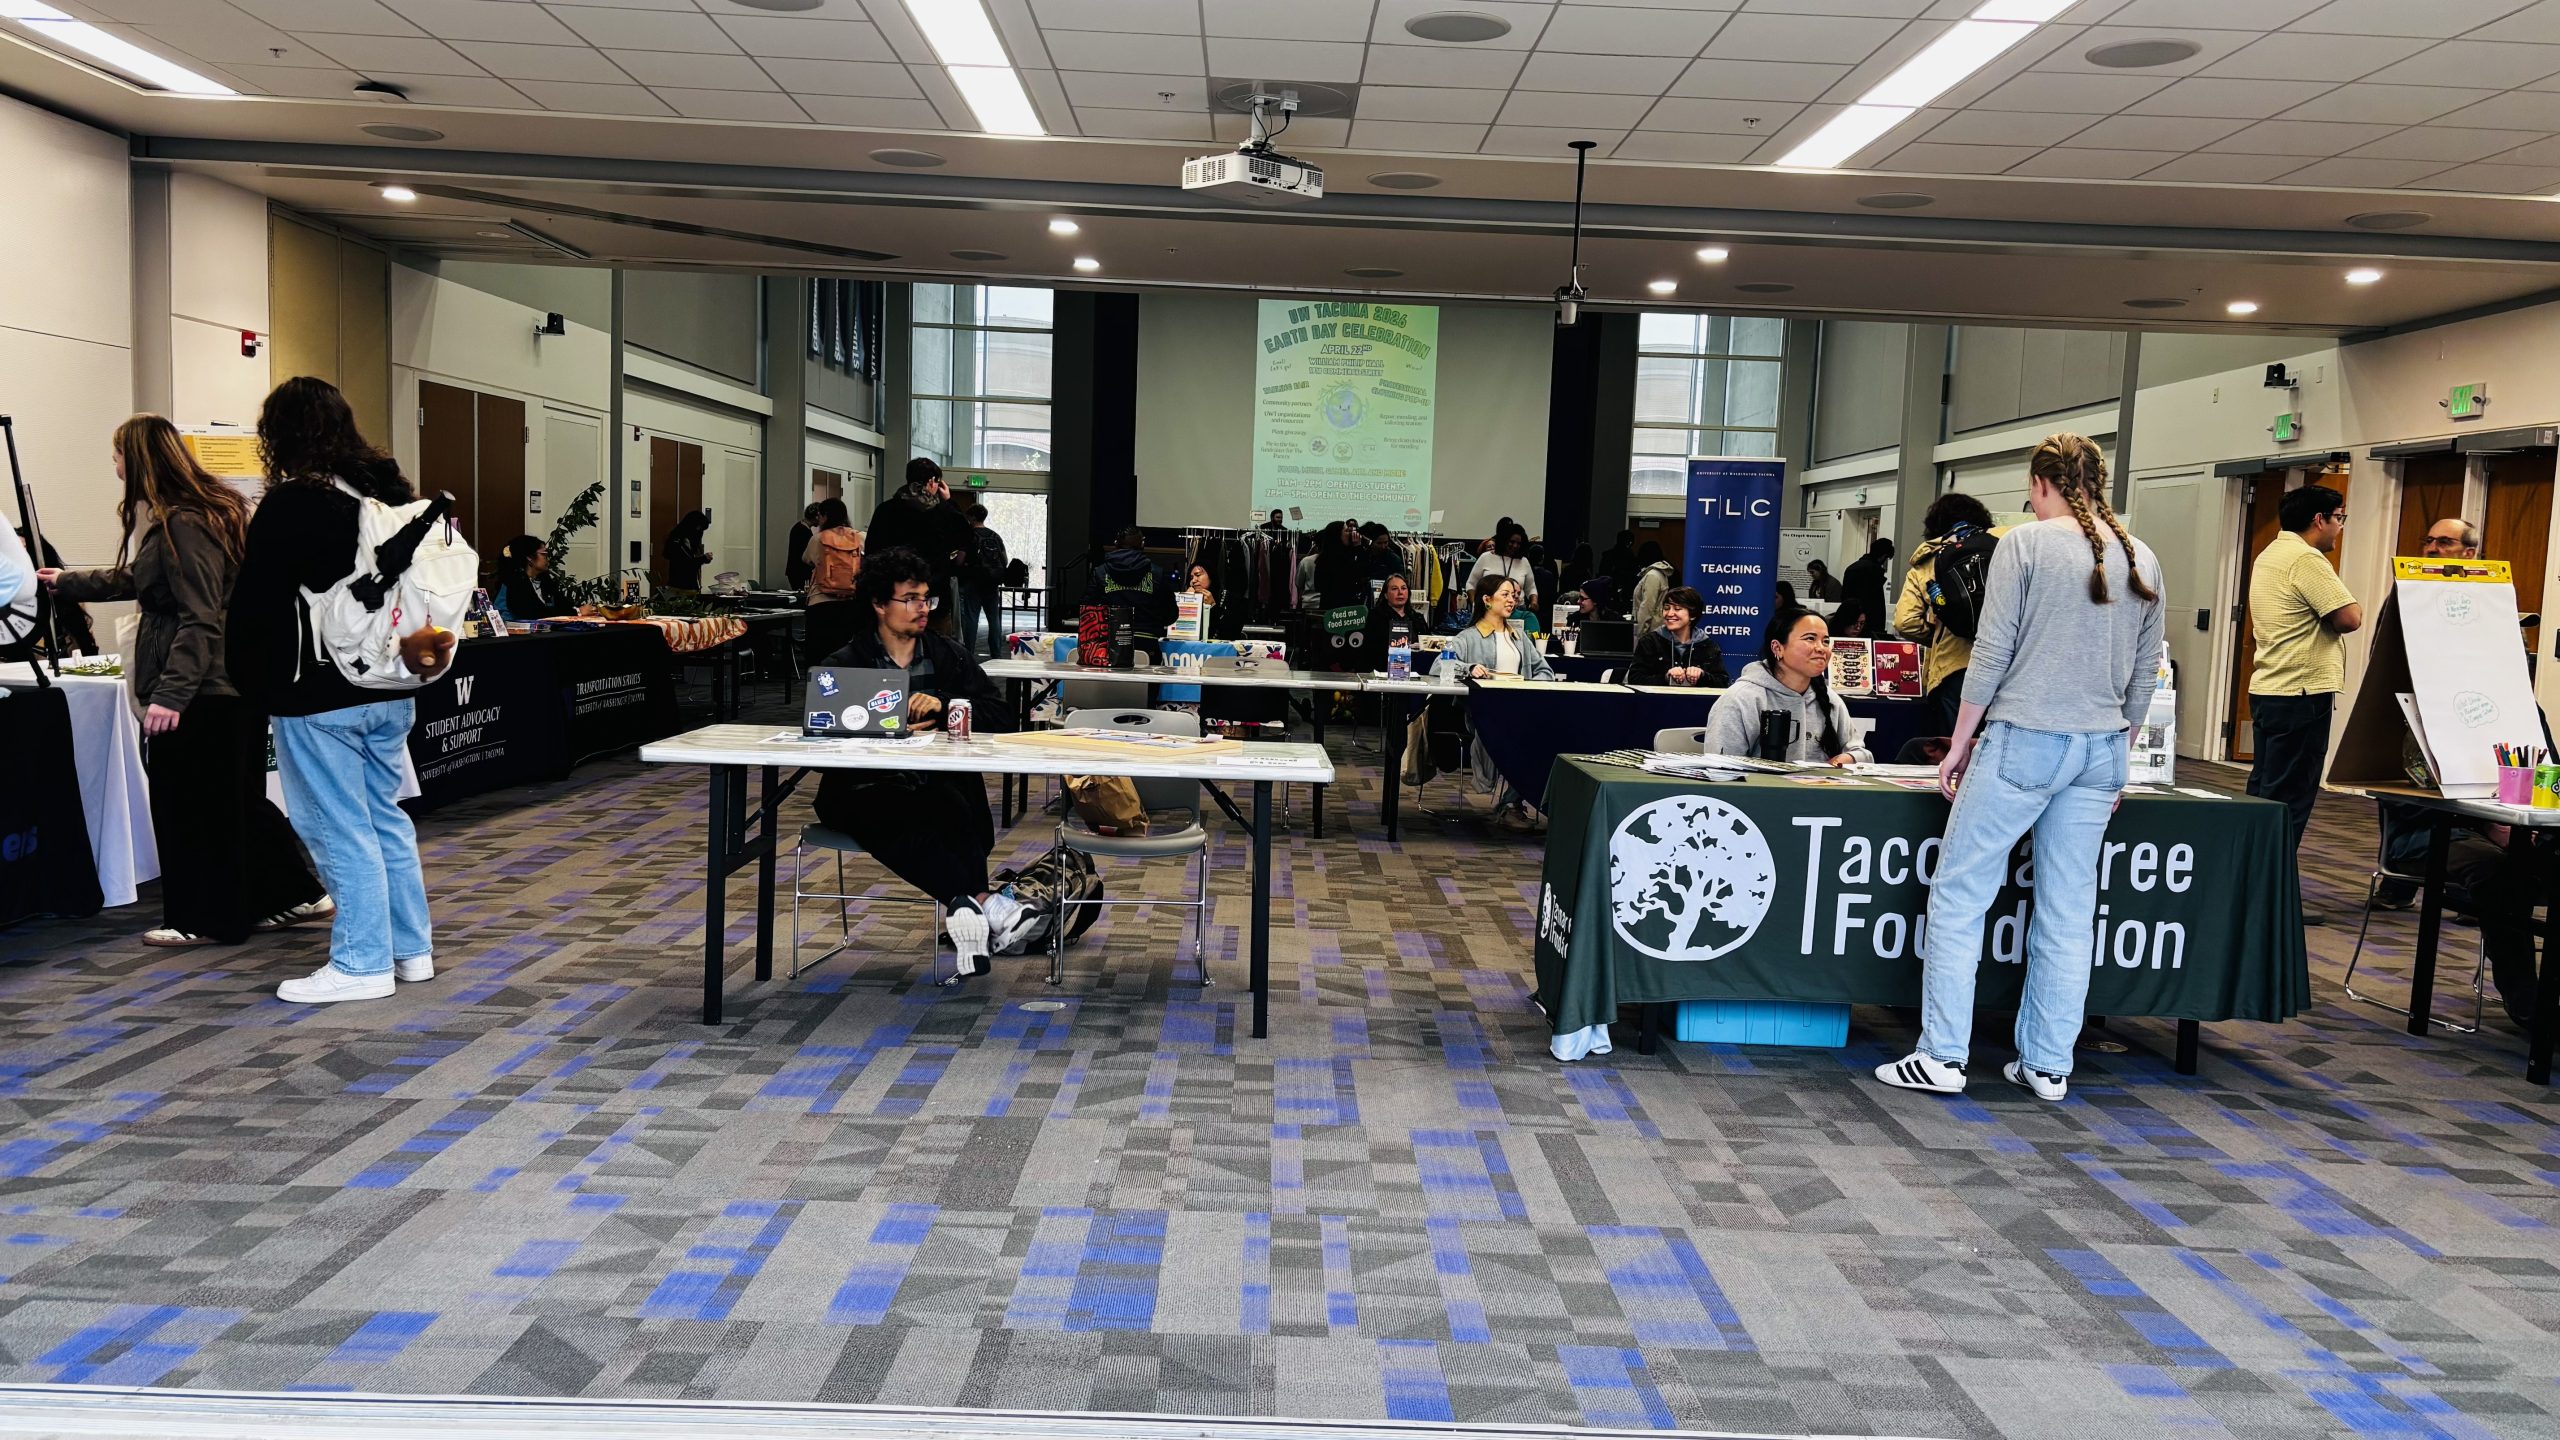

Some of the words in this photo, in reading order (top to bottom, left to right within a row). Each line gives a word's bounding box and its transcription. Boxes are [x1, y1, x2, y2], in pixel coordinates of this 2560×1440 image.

[1288, 306, 1310, 324] UW
[1314, 303, 1368, 318] TACOMA
[1264, 327, 1308, 354] EARTH
[1311, 323, 1338, 340] DAY
[1342, 323, 1431, 360] CELEBRATION
[1320, 344, 1350, 355] APRIL
[1308, 357, 1340, 366] WILLIAM
[1366, 359, 1384, 368] HALL
[1304, 480, 1322, 489] 2PM
[1326, 480, 1350, 489] OPEN
[1350, 481, 1364, 489] TO
[1364, 482, 1407, 491] STUDENTS
[1265, 489, 1283, 497] 2PM
[1309, 491, 1333, 499] OPEN
[1334, 491, 1347, 499] TO
[1349, 492, 1364, 500] THE
[1366, 493, 1418, 502] COMMUNITY
[1701, 564, 1761, 575] TEACHING
[1717, 585, 1742, 595] AND
[1332, 611, 1347, 619] feed
[1702, 605, 1759, 616] EARNING
[1328, 619, 1343, 629] food
[1343, 616, 1366, 626] scraps!
[1704, 626, 1751, 636] CENTER
[1161, 652, 1212, 667] ACOM
[454, 675, 475, 706] W
[869, 696, 886, 708] BLUE
[426, 715, 461, 739] STUDENT
[461, 706, 500, 729] ADVOCACY
[441, 737, 449, 753] &
[449, 727, 483, 751] SUPPORT
[1792, 817, 2034, 955] Tacoa
[2100, 842, 2194, 893] ree
[1833, 893, 2186, 970] Fodion
